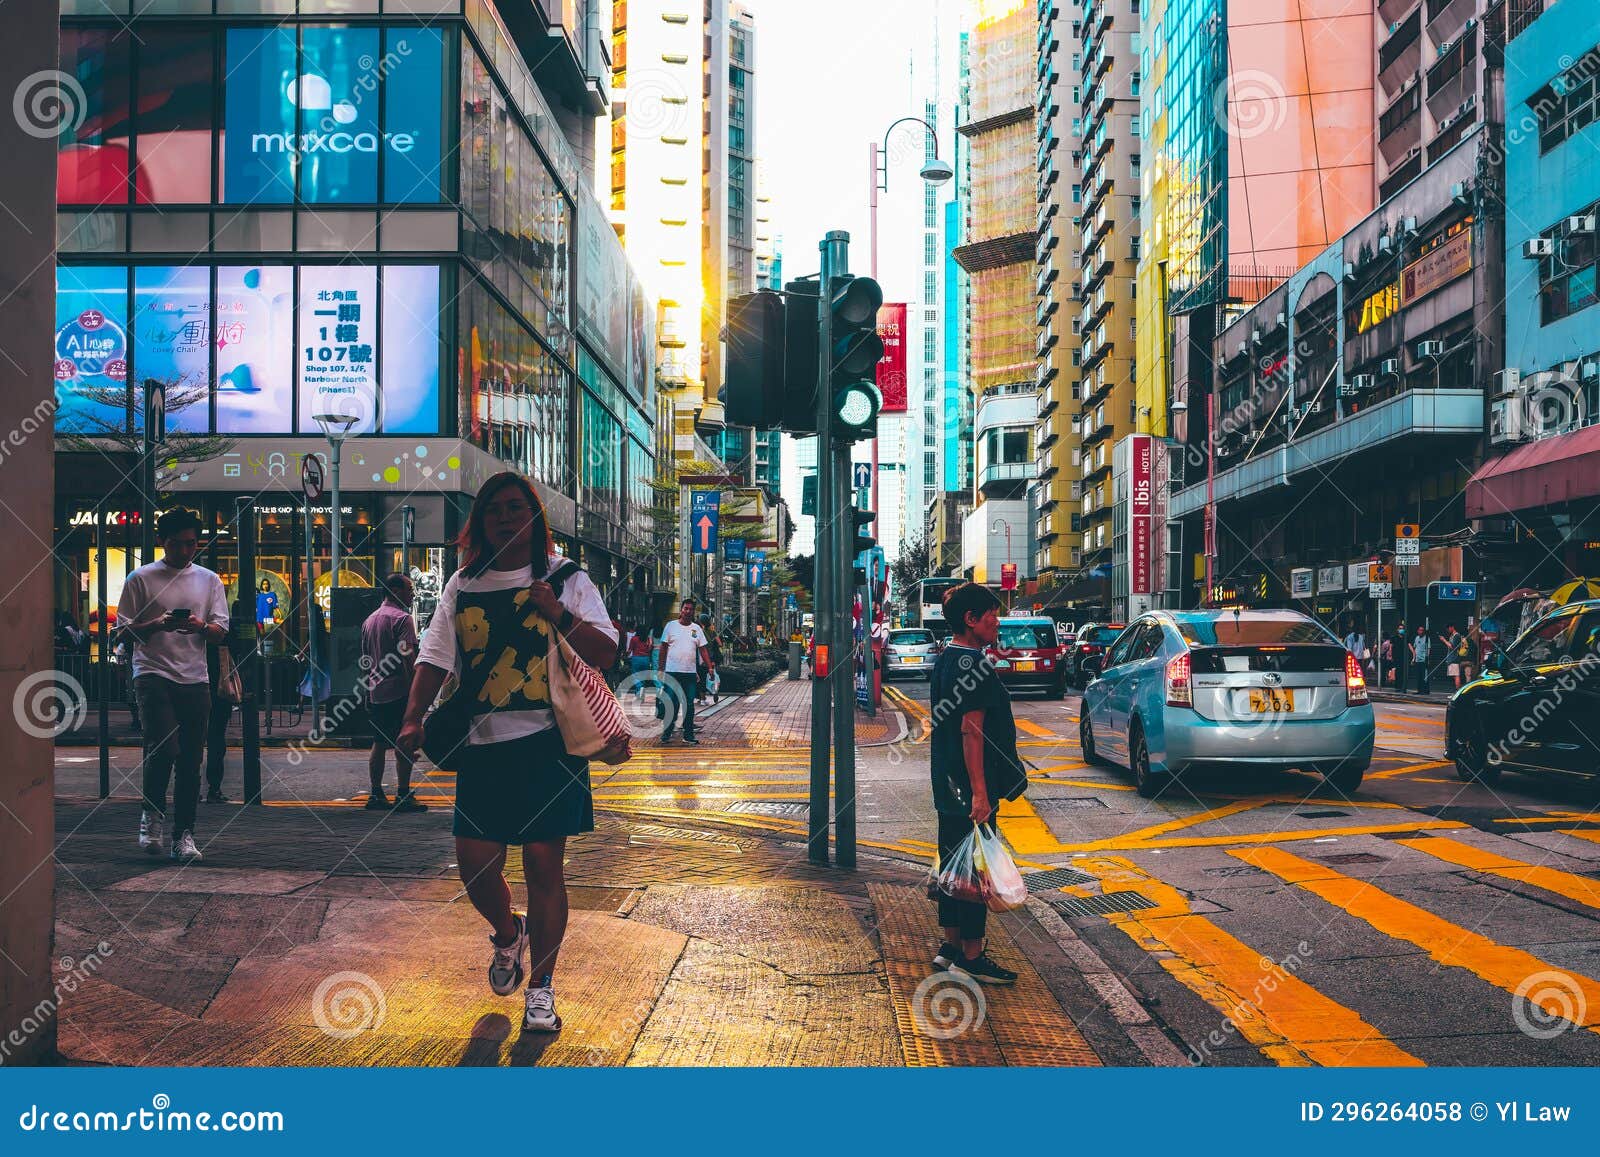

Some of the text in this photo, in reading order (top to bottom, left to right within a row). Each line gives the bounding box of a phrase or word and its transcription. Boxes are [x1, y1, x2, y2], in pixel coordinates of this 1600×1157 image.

[252, 132, 415, 153] maxcare
[314, 304, 360, 322] 一期
[305, 344, 373, 362] 107號
[1135, 447, 1150, 505] ibis HOTEL
[696, 495, 704, 504] P
[1252, 701, 1292, 712] 7206
